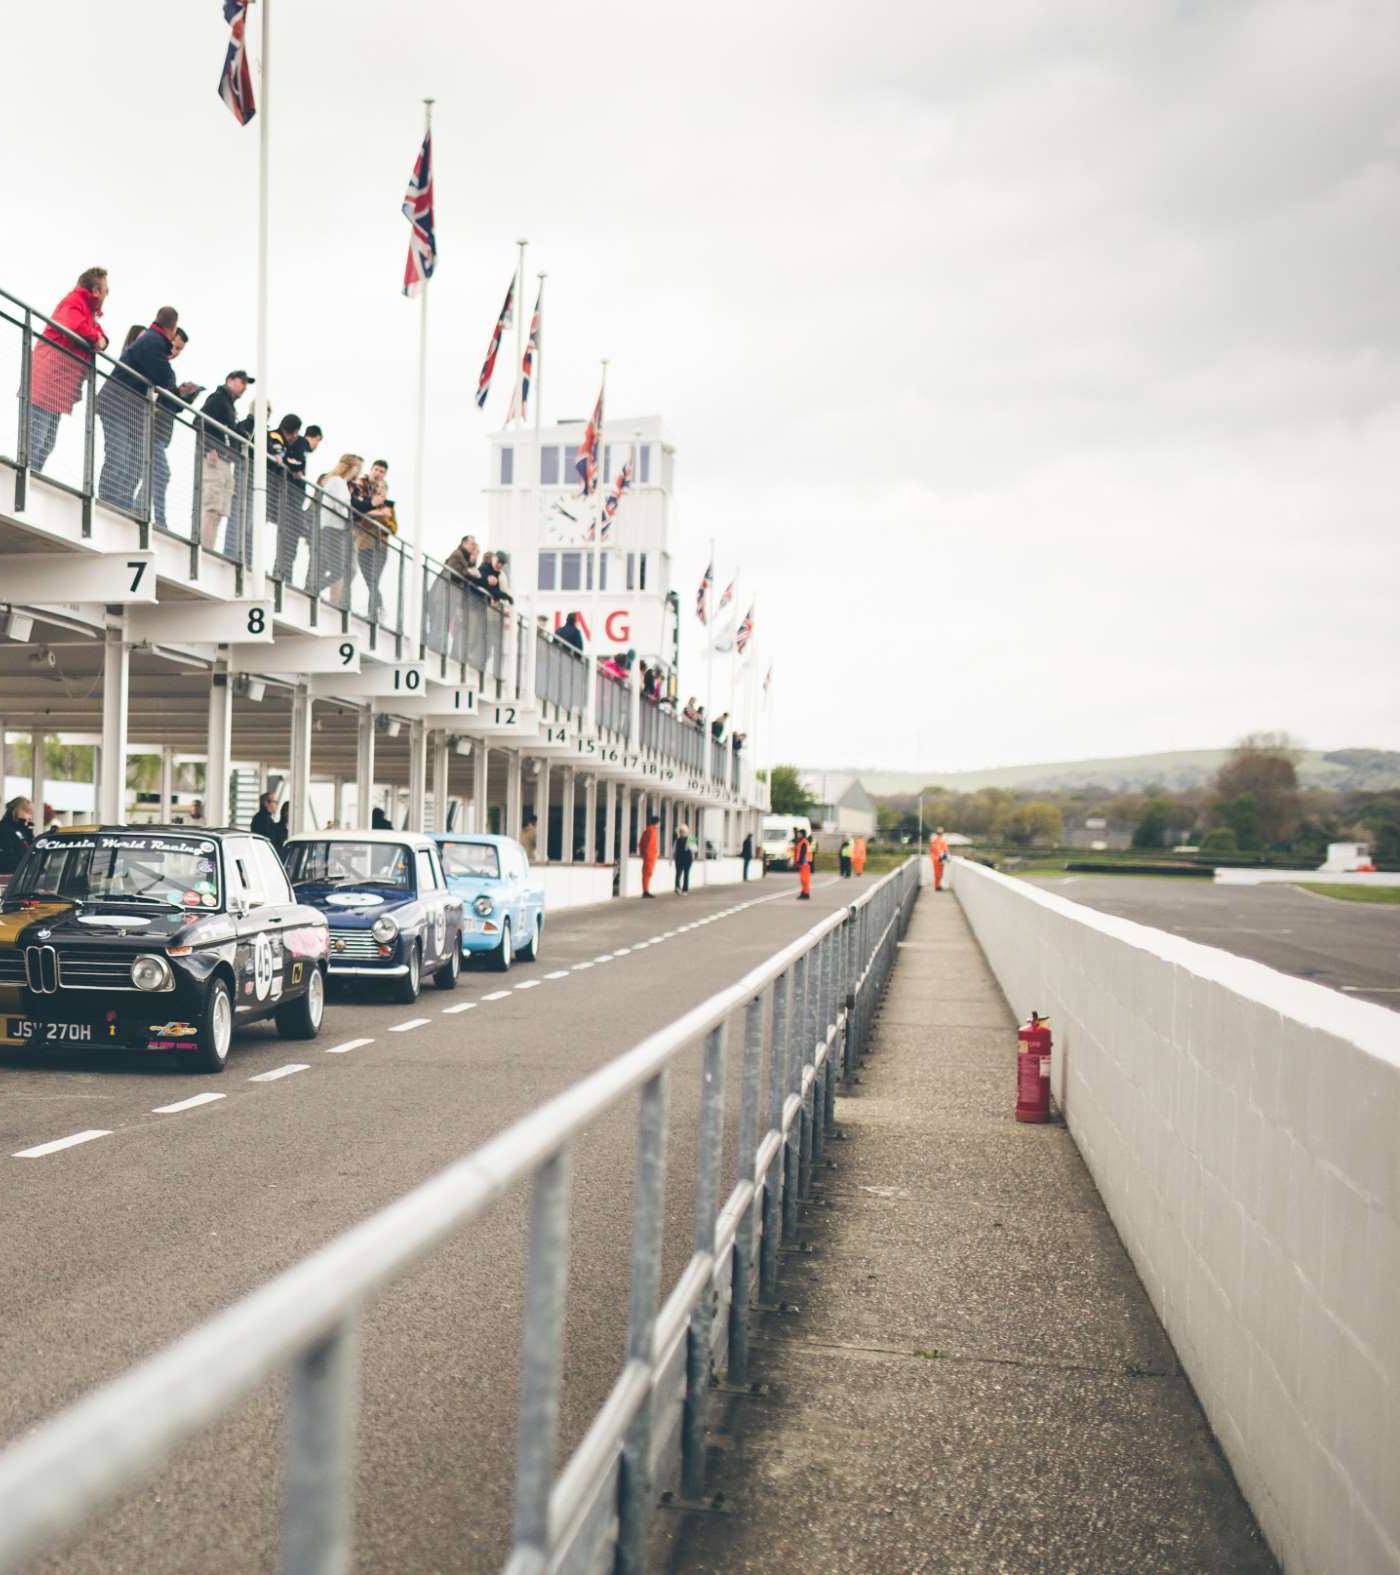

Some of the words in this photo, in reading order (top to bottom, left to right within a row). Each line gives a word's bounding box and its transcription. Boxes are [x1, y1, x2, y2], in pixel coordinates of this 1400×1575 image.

[127, 561, 148, 593] 7
[247, 607, 265, 634] 8
[339, 642, 355, 665] 9
[394, 669, 420, 690] 10
[455, 690, 473, 709] 11
[495, 707, 516, 724] 12
[547, 728, 566, 742] 14
[578, 739, 595, 753] 15
[601, 749, 618, 762] 16
[623, 756, 638, 768] 17
[642, 763, 657, 774] 18
[660, 770, 674, 781] 19
[44, 838, 96, 850] Classic
[102, 838, 147, 849] World
[150, 839, 204, 856] Racing
[46, 1022, 92, 1041] 270H
